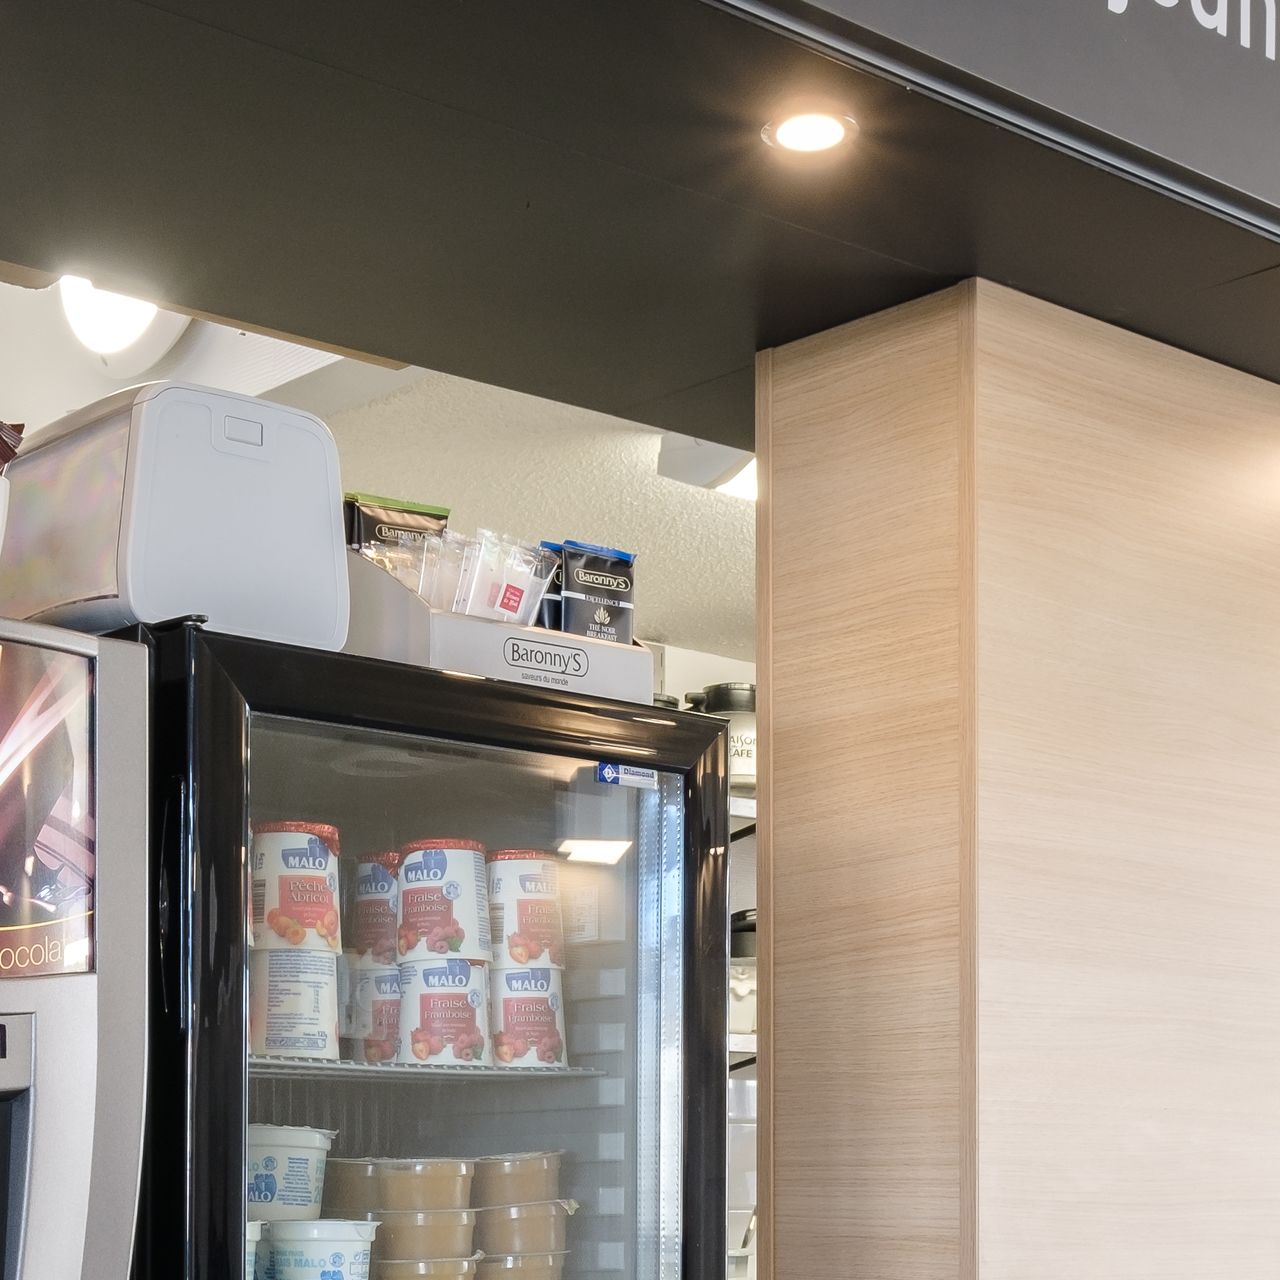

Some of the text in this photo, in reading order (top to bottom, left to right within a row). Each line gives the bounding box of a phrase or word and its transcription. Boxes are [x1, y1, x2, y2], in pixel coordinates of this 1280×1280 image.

[288, 856, 326, 870] MALO
[407, 869, 442, 882] MALO
[428, 975, 467, 987] MALO
[511, 979, 548, 991] MALO
